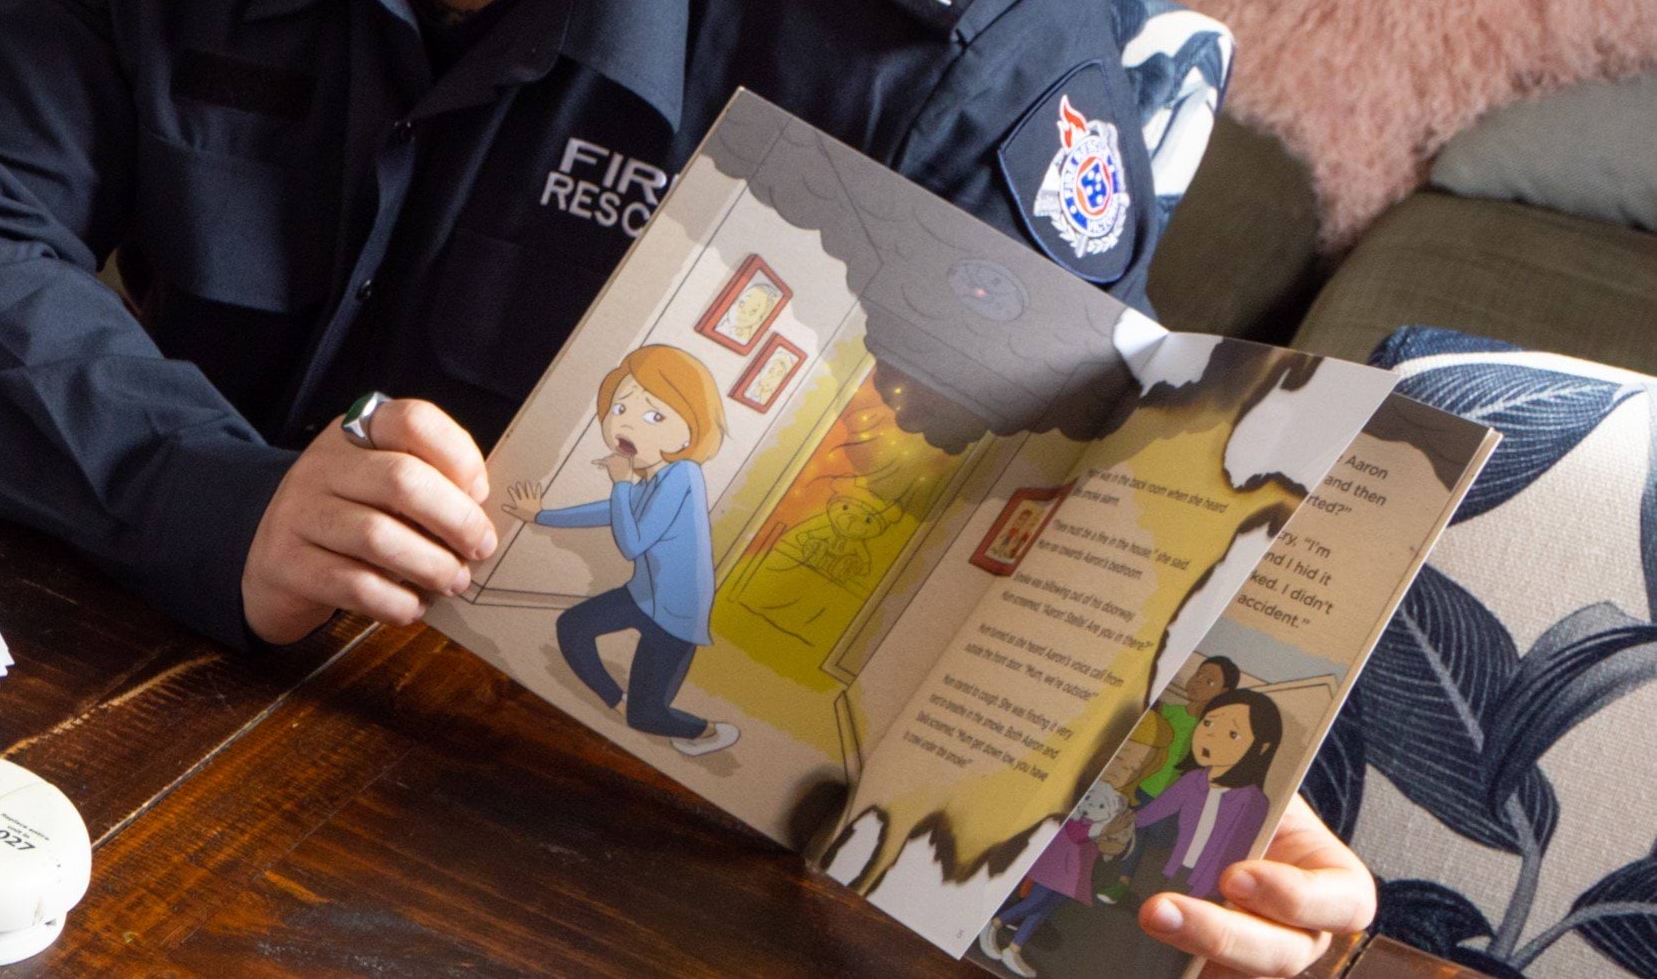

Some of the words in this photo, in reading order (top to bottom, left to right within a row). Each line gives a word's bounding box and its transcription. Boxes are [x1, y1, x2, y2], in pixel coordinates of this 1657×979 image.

[559, 137, 679, 205] FIR
[540, 171, 651, 238] RESC
[1345, 455, 1388, 480] Aaron
[1117, 475, 1129, 485] the
[1129, 477, 1146, 489] back
[1147, 483, 1167, 494] room
[1167, 489, 1188, 500] when
[1187, 494, 1203, 506] she
[1203, 498, 1229, 513] heard
[1324, 474, 1352, 492] and
[1354, 485, 1387, 506] then
[1155, 552, 1171, 564] she
[1286, 559, 1294, 569] I
[1294, 561, 1318, 581] hid
[1319, 573, 1332, 587] it
[1281, 584, 1289, 594] I
[1090, 596, 1102, 609] his
[1086, 620, 1100, 633] Are
[1098, 628, 1115, 639] you
[1114, 633, 1123, 641] in
[1070, 661, 1091, 674] voice
[1089, 668, 1107, 679] call
[1104, 671, 1124, 687] from
[1026, 709, 1050, 730] finding
[1049, 722, 1057, 731] it
[1056, 726, 1074, 740] very
[1021, 735, 1044, 751] Aaron
[1042, 746, 1060, 759] and
[1013, 760, 1030, 772] you
[1030, 765, 1048, 781] have
